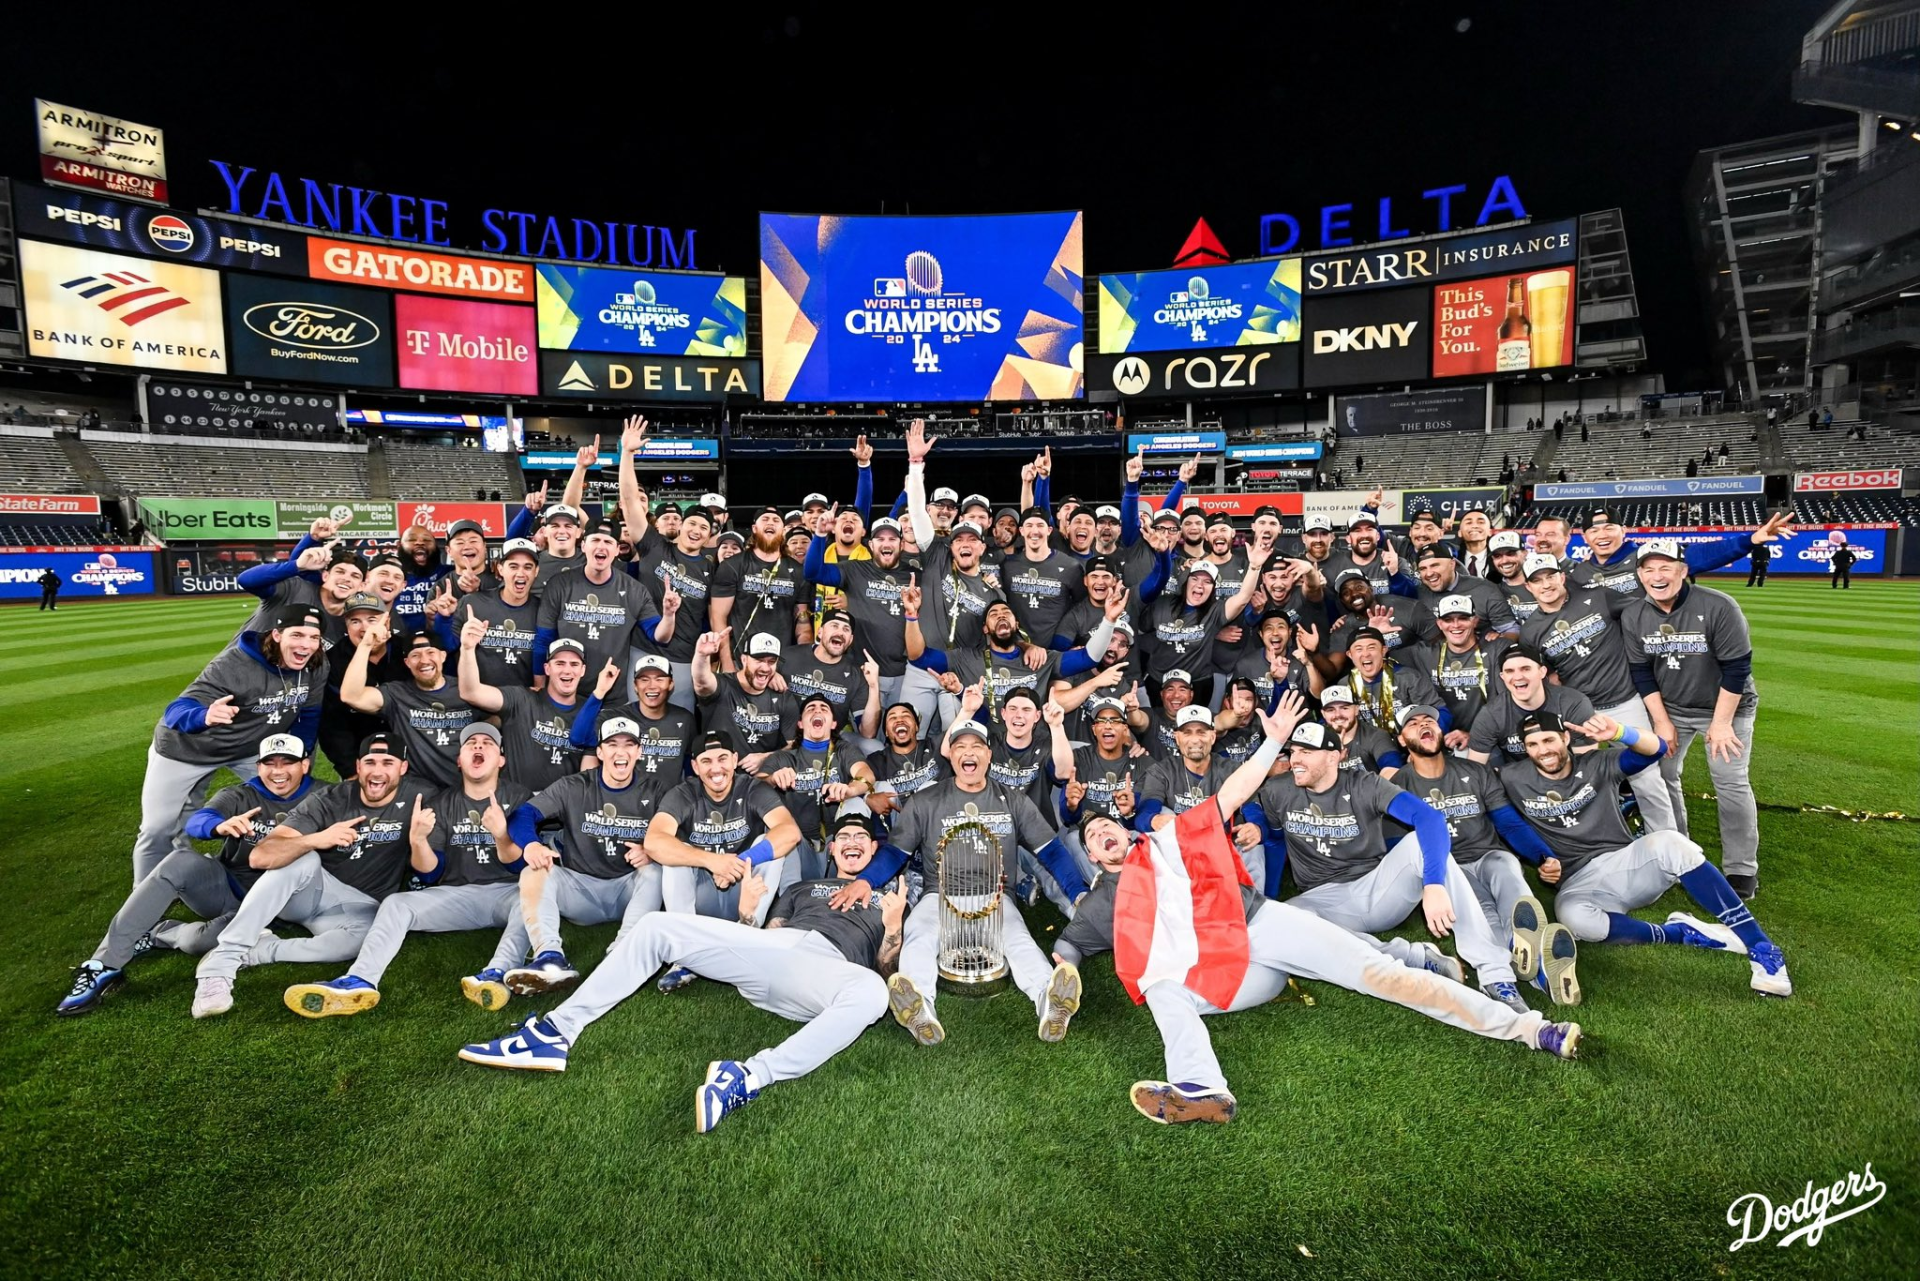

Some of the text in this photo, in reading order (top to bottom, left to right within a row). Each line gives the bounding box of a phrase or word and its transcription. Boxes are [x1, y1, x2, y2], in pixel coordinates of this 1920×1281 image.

[43, 110, 157, 146] ARMITRON
[53, 161, 155, 191] ARMITRON
[106, 181, 154, 198] WATCHES
[46, 204, 121, 232] PEPSI
[209, 159, 698, 269] YANKEE STADIUM
[1260, 175, 1527, 256] DELTA
[152, 227, 191, 241] PEPSI
[219, 236, 281, 258] PEPSI
[1308, 233, 1570, 290] STARR INSURANCE
[323, 247, 525, 294] GATORADE
[864, 298, 982, 309] WORLD SERIES
[1198, 299, 1231, 307] SERIES
[1440, 287, 1484, 306] This
[610, 304, 644, 312] WORLD
[1154, 304, 1242, 323] CHAMPIONS
[1440, 302, 1493, 322] Bud's
[269, 307, 357, 344] Ford
[599, 309, 690, 328] CHAMPIONS
[845, 308, 1000, 334] CHAMPIONS
[639, 326, 656, 346] LA
[1191, 320, 1208, 341] LA
[1313, 320, 1418, 354] DKNY
[1441, 323, 1472, 339] For
[33, 329, 221, 360] BANK OF AMERICA
[943, 335, 960, 343] 24
[1440, 339, 1481, 355] You.
[436, 332, 529, 363] Mobile
[912, 334, 938, 372] LA
[271, 348, 359, 364] BuyFordNow.com
[608, 363, 749, 392] DELTA
[1165, 352, 1270, 390] razr
[209, 403, 285, 417] New York Yankees
[1425, 421, 1452, 429] BOSS
[1628, 484, 1667, 492] FANDUEL
[1702, 481, 1744, 490] FANDUEL
[1797, 470, 1899, 490] Reebok
[1560, 487, 1596, 495] FANDUEL
[280, 503, 327, 513] Morningside
[371, 512, 392, 520] Circle
[213, 510, 271, 528] Eats
[72, 572, 144, 583] CHAMPIONS
[744, 575, 795, 588] WORLD SERIES
[868, 581, 896, 590] WORLD
[1012, 577, 1062, 588] WORLD SERIES
[1604, 573, 1635, 587] SERIES
[743, 581, 794, 597] CHAMPIONS
[1010, 583, 1061, 597] CHAMPIONS
[763, 593, 774, 609] LA
[890, 600, 900, 615] LA
[1029, 593, 1039, 608] LA
[565, 603, 625, 615] WORLD SERIES
[563, 612, 625, 625] CHAMPIONS
[587, 622, 599, 640] LA
[1156, 630, 1205, 642] CHAMPIONS
[1159, 624, 1204, 634] WORLD SERIES
[1542, 613, 1602, 648] WORLD SERIES
[1544, 620, 1606, 656] CHAMPIONS
[1641, 634, 1706, 645] WORLD SERIES
[1175, 641, 1186, 654] LA
[1575, 644, 1590, 658] LA
[1643, 643, 1708, 654] CHAMPIONS
[505, 648, 516, 664] LA
[1667, 654, 1680, 670] LA
[791, 676, 847, 694] WORLD SERIES
[1010, 674, 1036, 684] SERIES
[1454, 687, 1467, 700] LA
[410, 710, 472, 719] WORLD SERIES
[436, 729, 450, 746] LA
[550, 746, 562, 764] LA
[645, 757, 657, 773] LA
[990, 763, 1017, 777] WORLD
[887, 773, 915, 785] WORLD
[1088, 781, 1116, 791] WORLD
[1445, 794, 1477, 808] SERIES
[1522, 783, 1594, 809] WORLD SERIES
[1525, 789, 1598, 818] CHAMPIONS
[584, 813, 648, 828] WORLD SERIES
[694, 819, 746, 833] WORLD SERIES
[979, 814, 1011, 823] SERIES
[1286, 812, 1357, 825] WORLD SERIES
[1561, 814, 1580, 828] LA
[689, 826, 750, 845] CHAMPIONS
[1285, 821, 1359, 838] CHAMPIONS
[475, 846, 490, 864] LA
[605, 839, 617, 856] LA
[1316, 838, 1331, 856] LA
